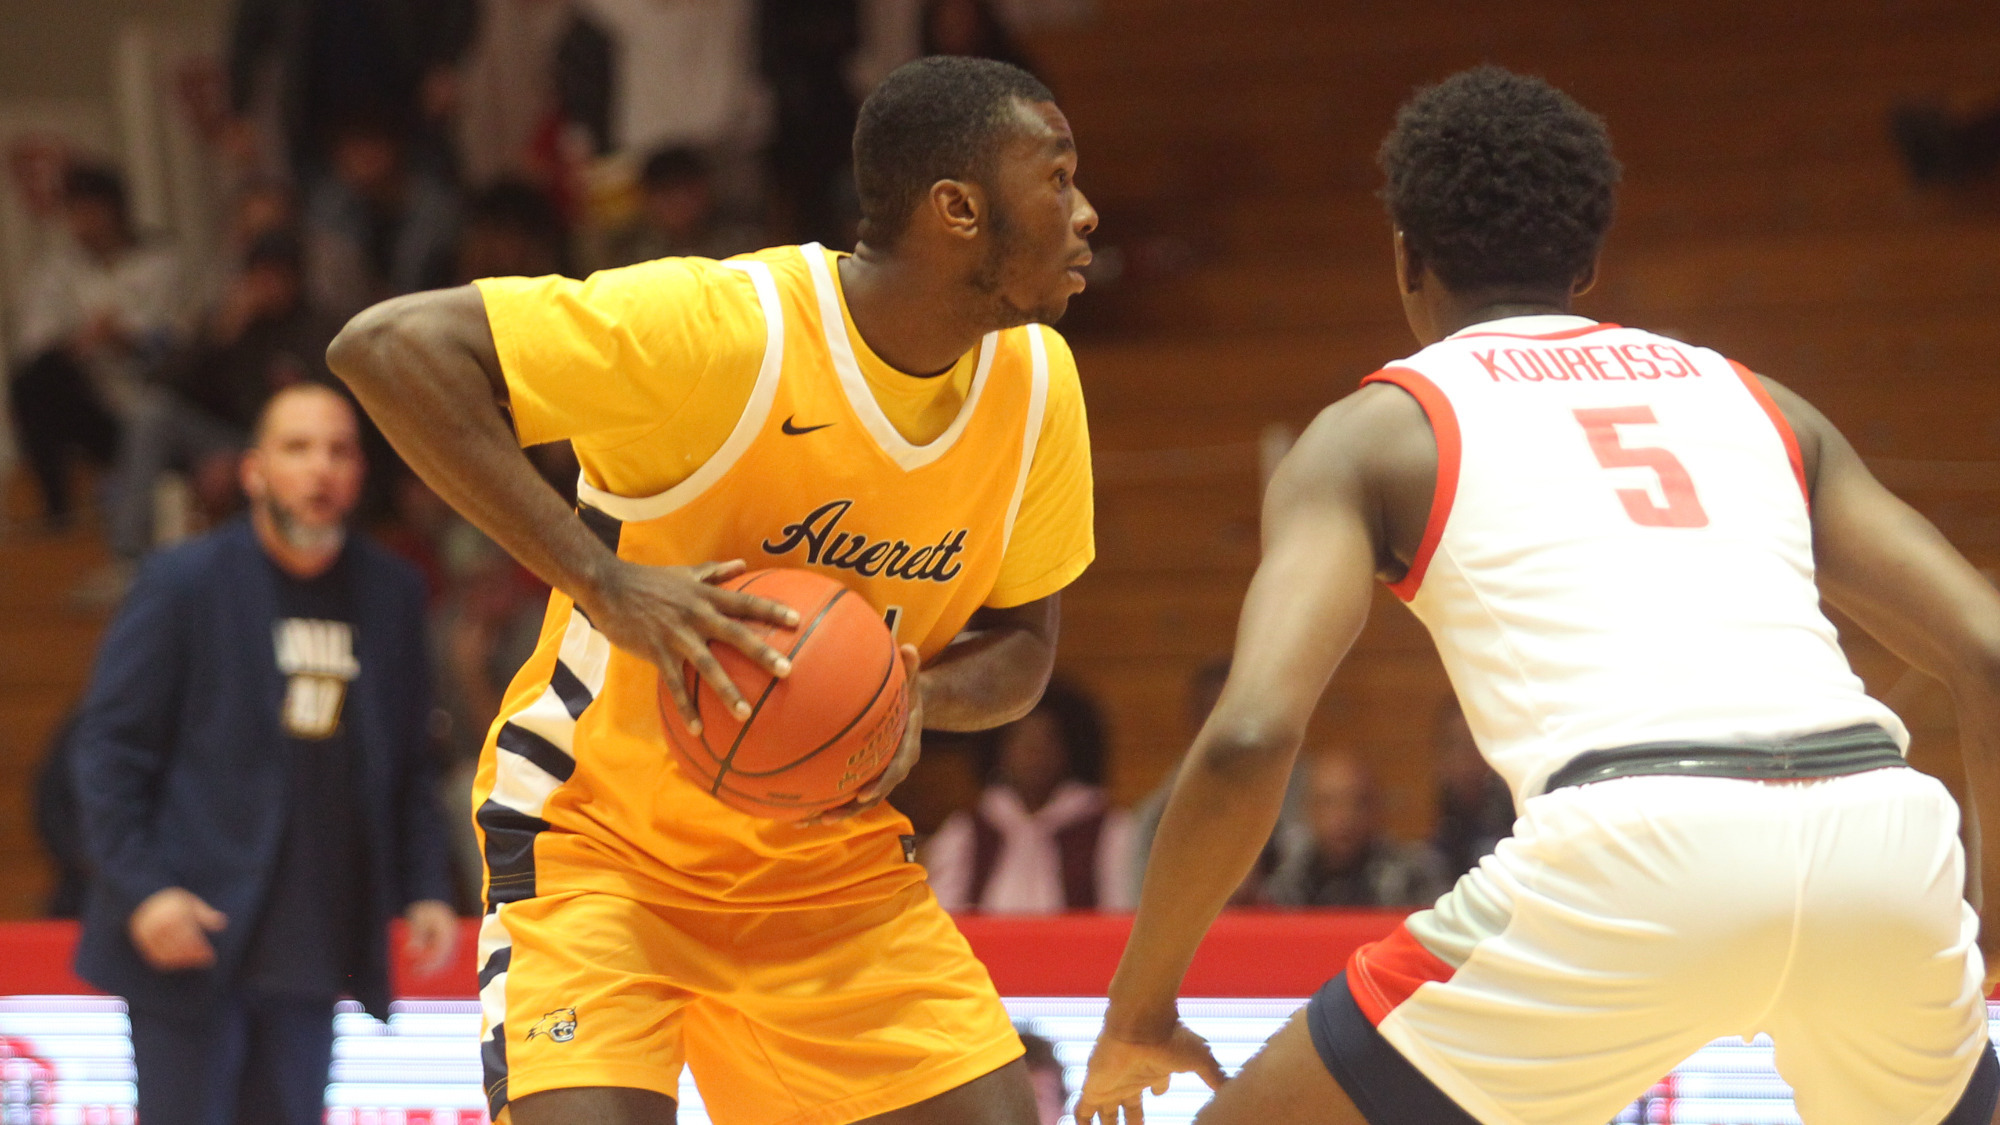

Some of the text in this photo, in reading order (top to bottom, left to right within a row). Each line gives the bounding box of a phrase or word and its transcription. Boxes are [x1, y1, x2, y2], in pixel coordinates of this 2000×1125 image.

[1470, 343, 1703, 383] KOUREISSI
[1570, 404, 1710, 529] 5
[761, 498, 969, 583] Averett
